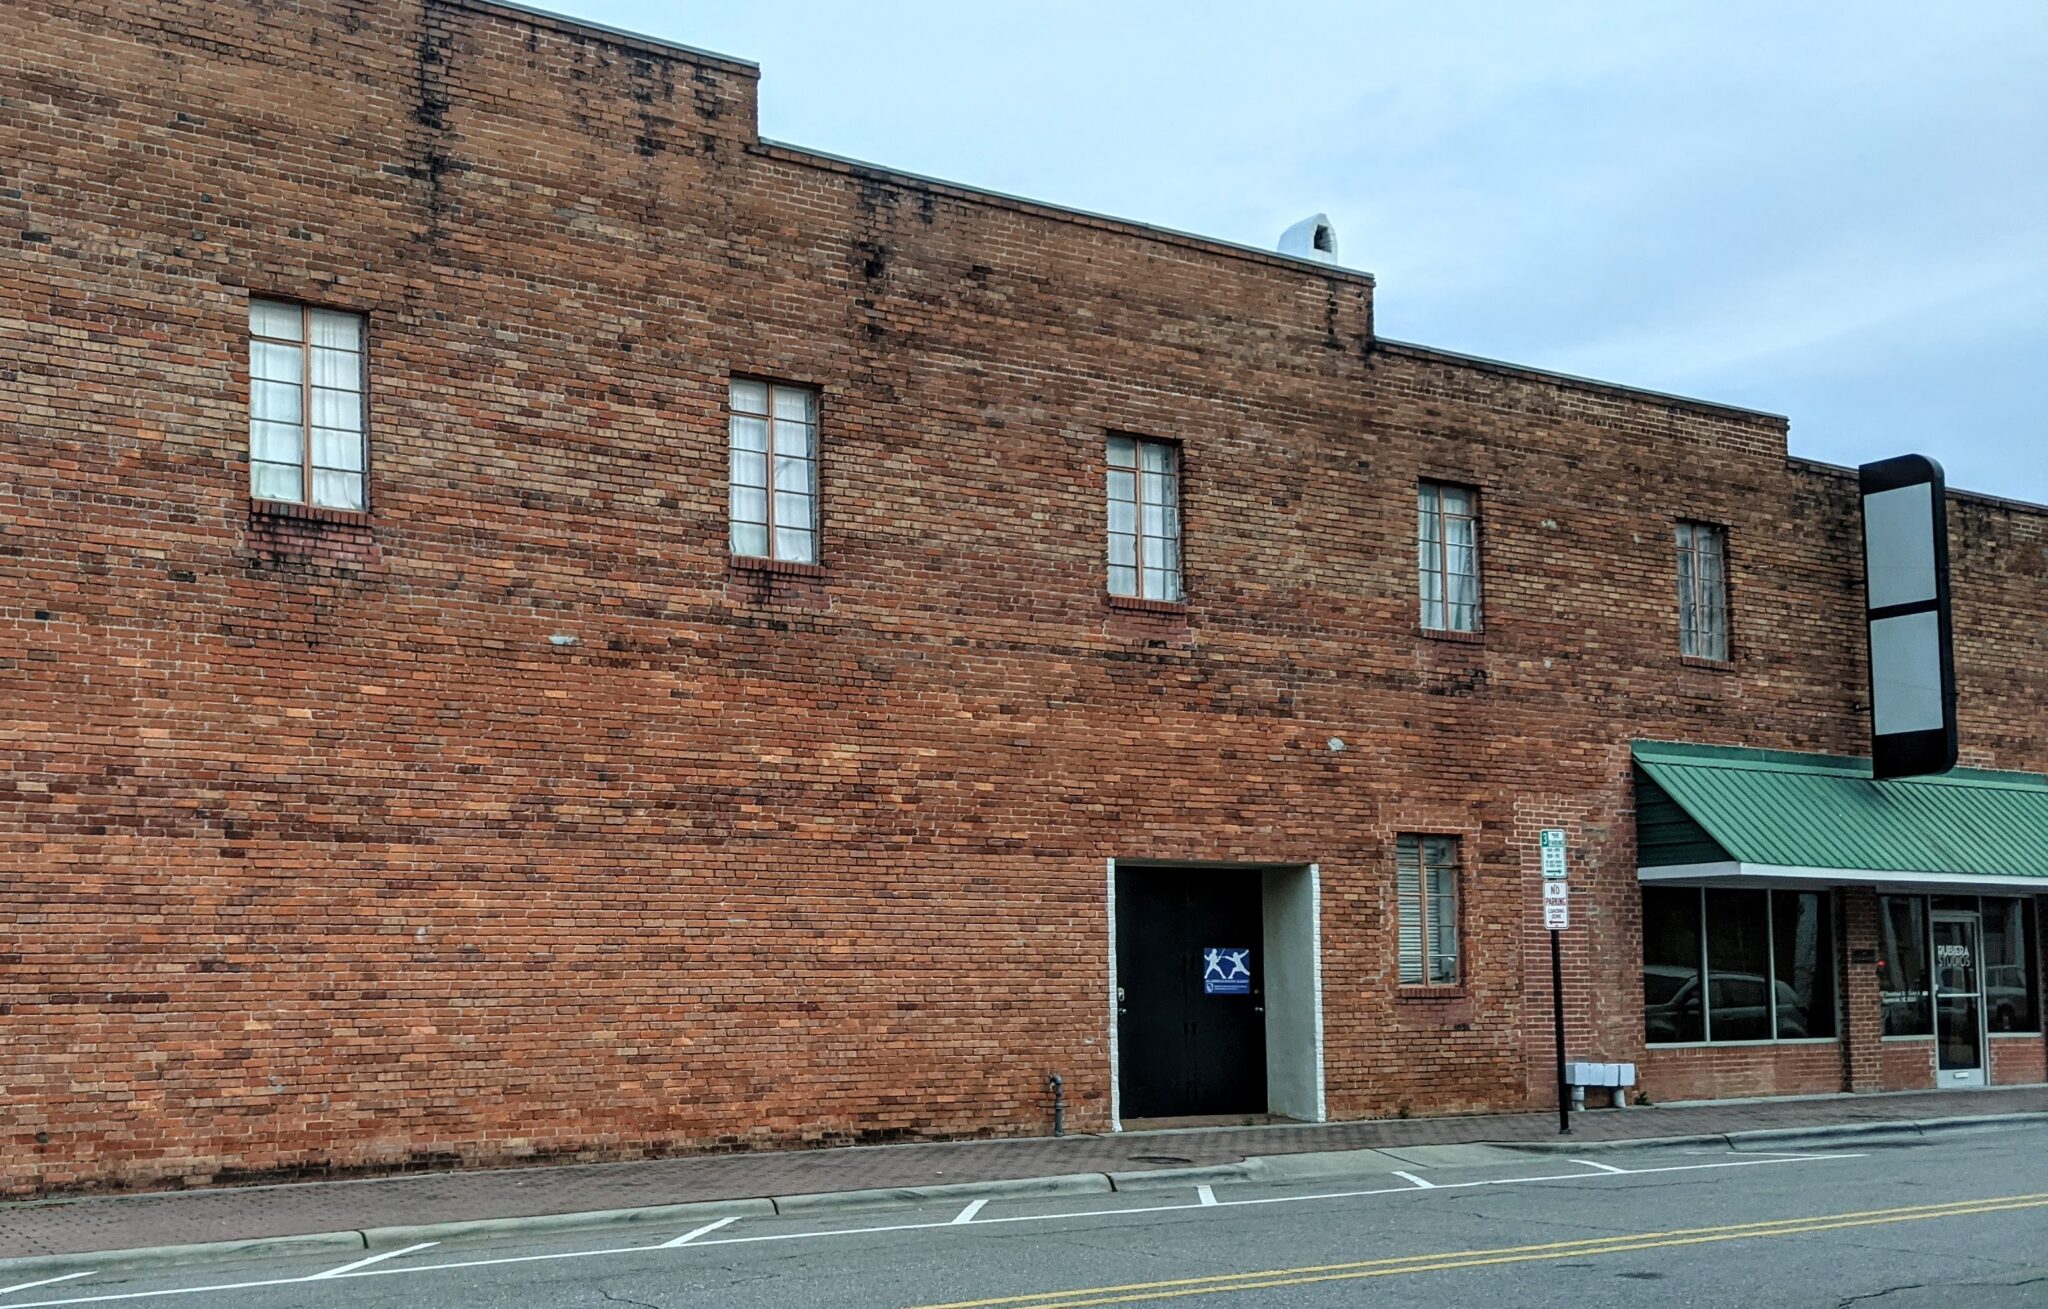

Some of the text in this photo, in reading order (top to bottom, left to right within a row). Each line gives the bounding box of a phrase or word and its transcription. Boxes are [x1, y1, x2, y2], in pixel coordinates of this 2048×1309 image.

[1542, 832, 1548, 845] 3
[1551, 885, 1560, 895] NO
[1545, 897, 1566, 906] PARKING
[1937, 945, 1970, 957] RUBIERA
[1938, 956, 1970, 967] STUDIOS
